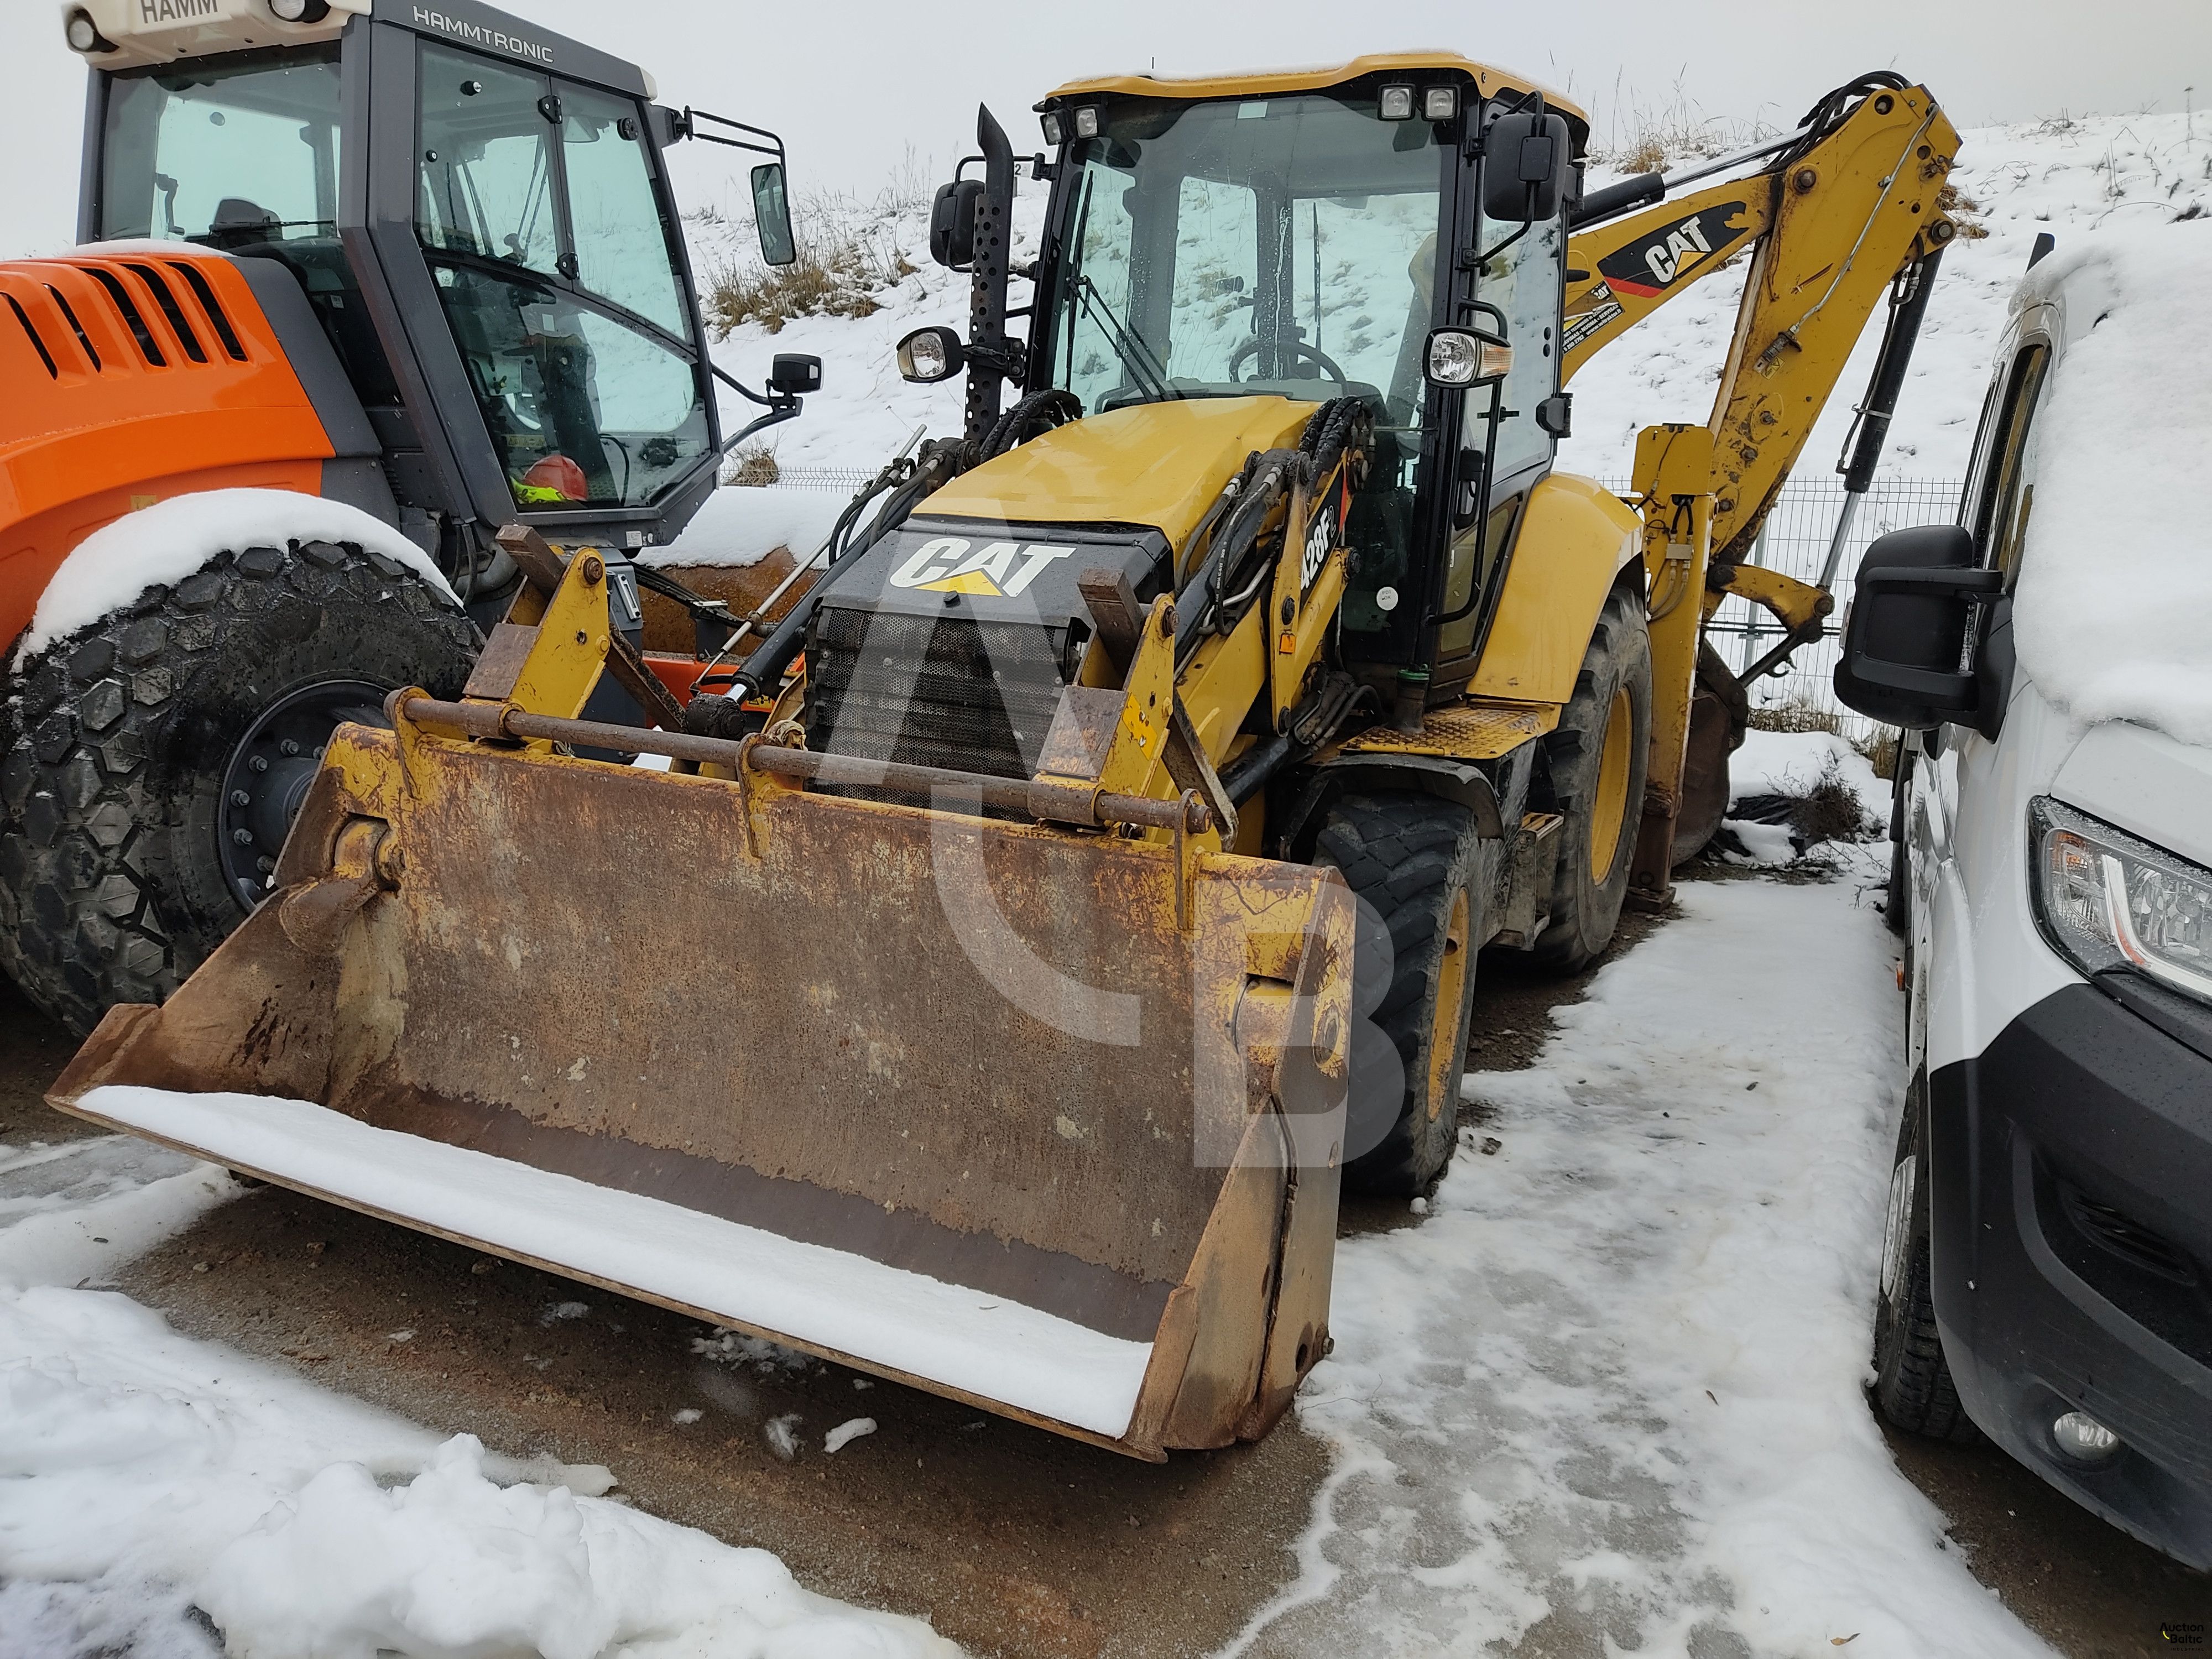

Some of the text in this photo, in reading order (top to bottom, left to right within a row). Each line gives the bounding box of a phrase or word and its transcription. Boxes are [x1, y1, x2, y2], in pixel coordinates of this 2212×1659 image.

[142, 0, 218, 24] HAMM
[413, 5, 554, 64] HAMMTRONIC
[1645, 216, 1712, 283] CAT
[1581, 318, 1598, 332] NUOMA
[1599, 305, 1619, 320] SERVISAS
[889, 538, 1076, 597] CAT
